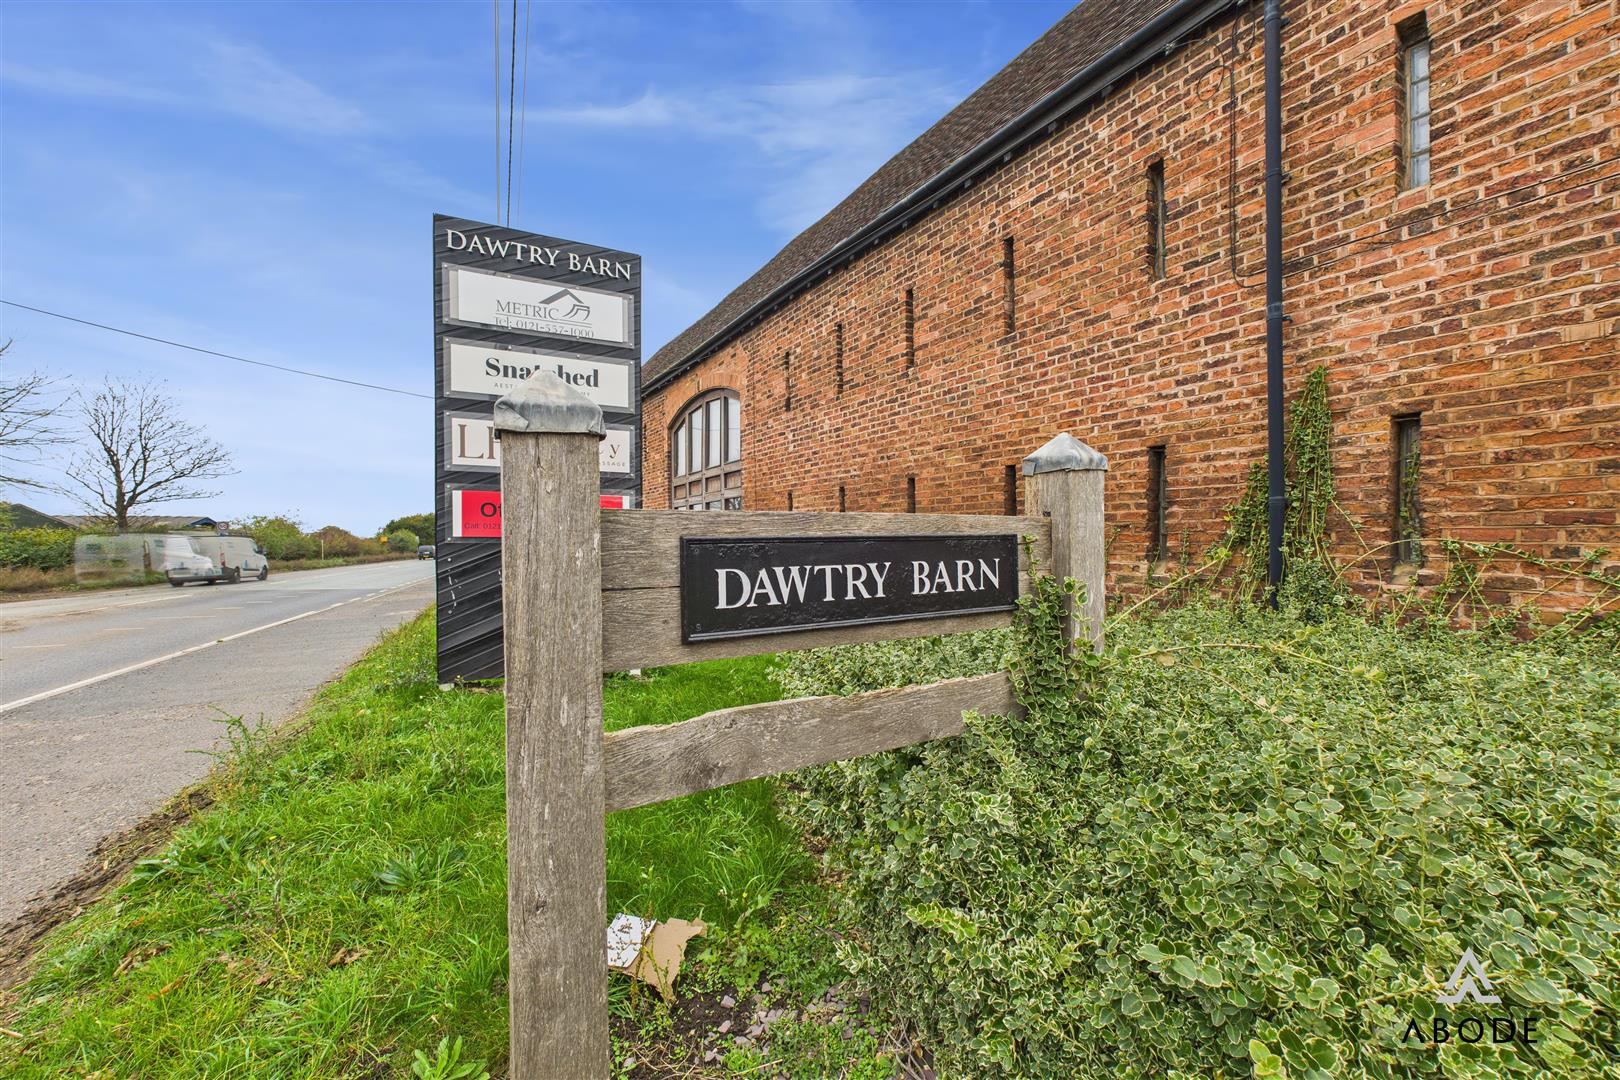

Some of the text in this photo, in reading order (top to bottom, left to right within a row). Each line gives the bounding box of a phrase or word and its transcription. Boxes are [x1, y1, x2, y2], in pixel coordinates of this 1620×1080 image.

[446, 229, 631, 281] DAWTRY BARN
[495, 299, 559, 321] METRIC
[515, 319, 594, 338] 0121-557-1000
[485, 357, 599, 388] Snahed
[714, 558, 1001, 610] DAWTRY BARN
